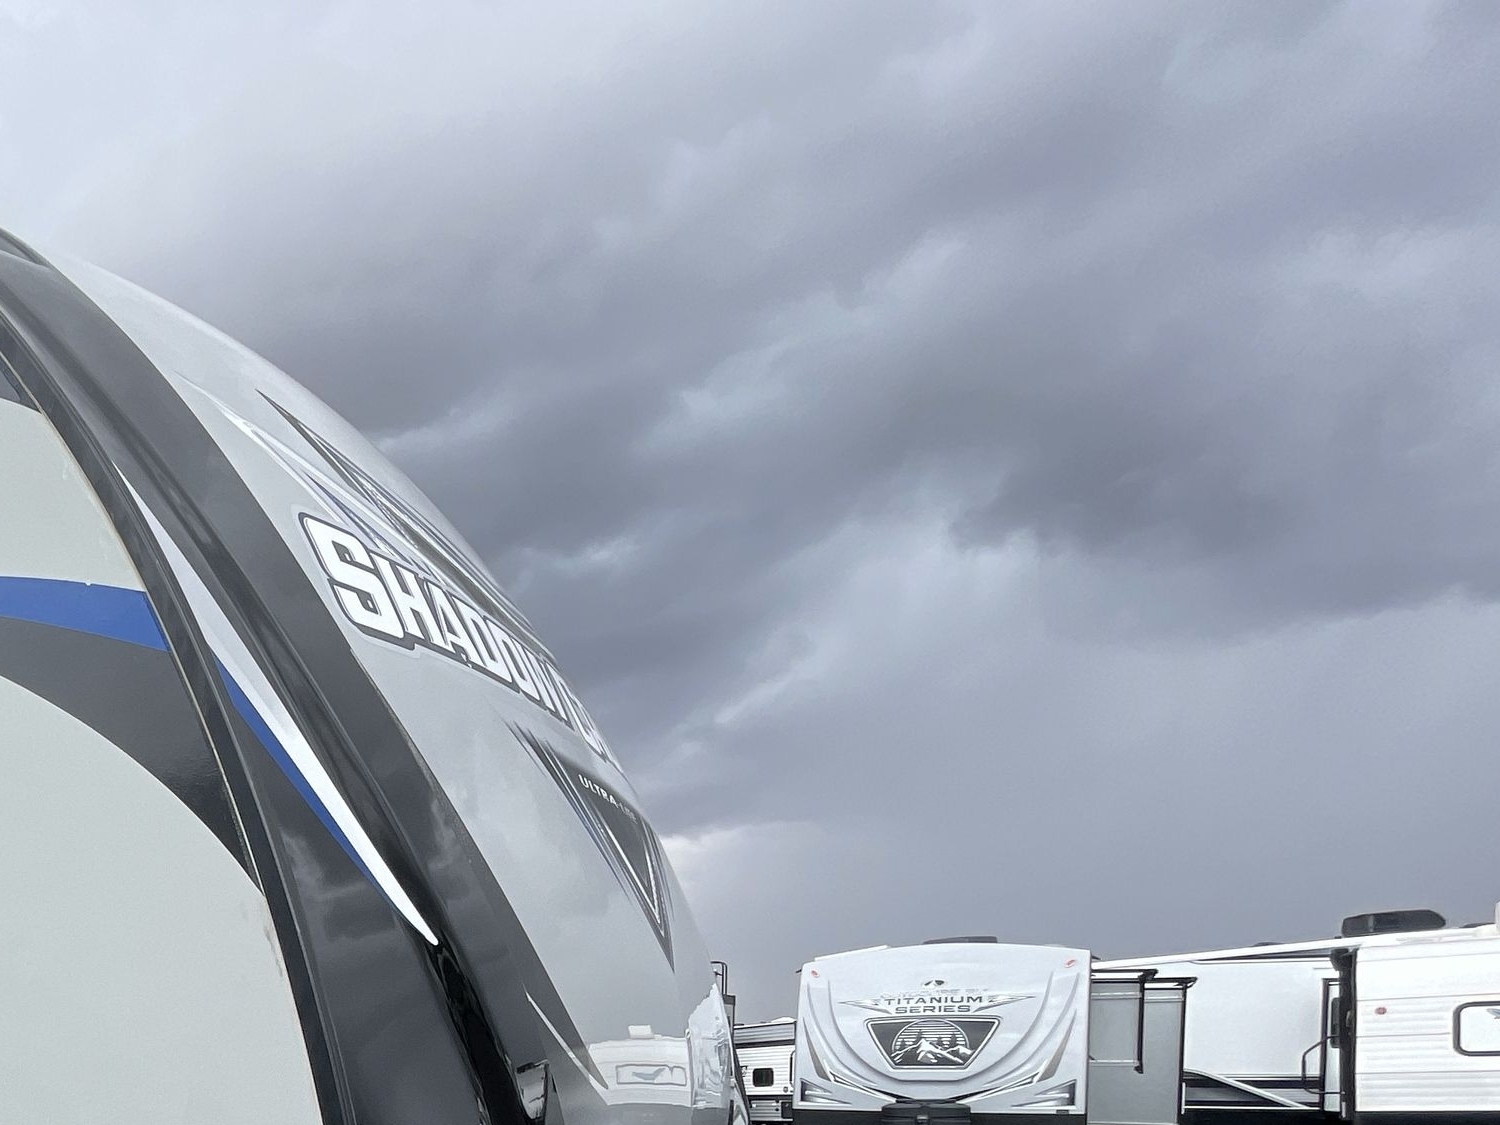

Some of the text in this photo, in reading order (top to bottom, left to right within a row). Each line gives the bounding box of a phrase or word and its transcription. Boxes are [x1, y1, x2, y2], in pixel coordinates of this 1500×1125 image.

[299, 513, 574, 730] SHADOW
[884, 996, 983, 1006] TITANIUM
[895, 1005, 971, 1014] SERIES
